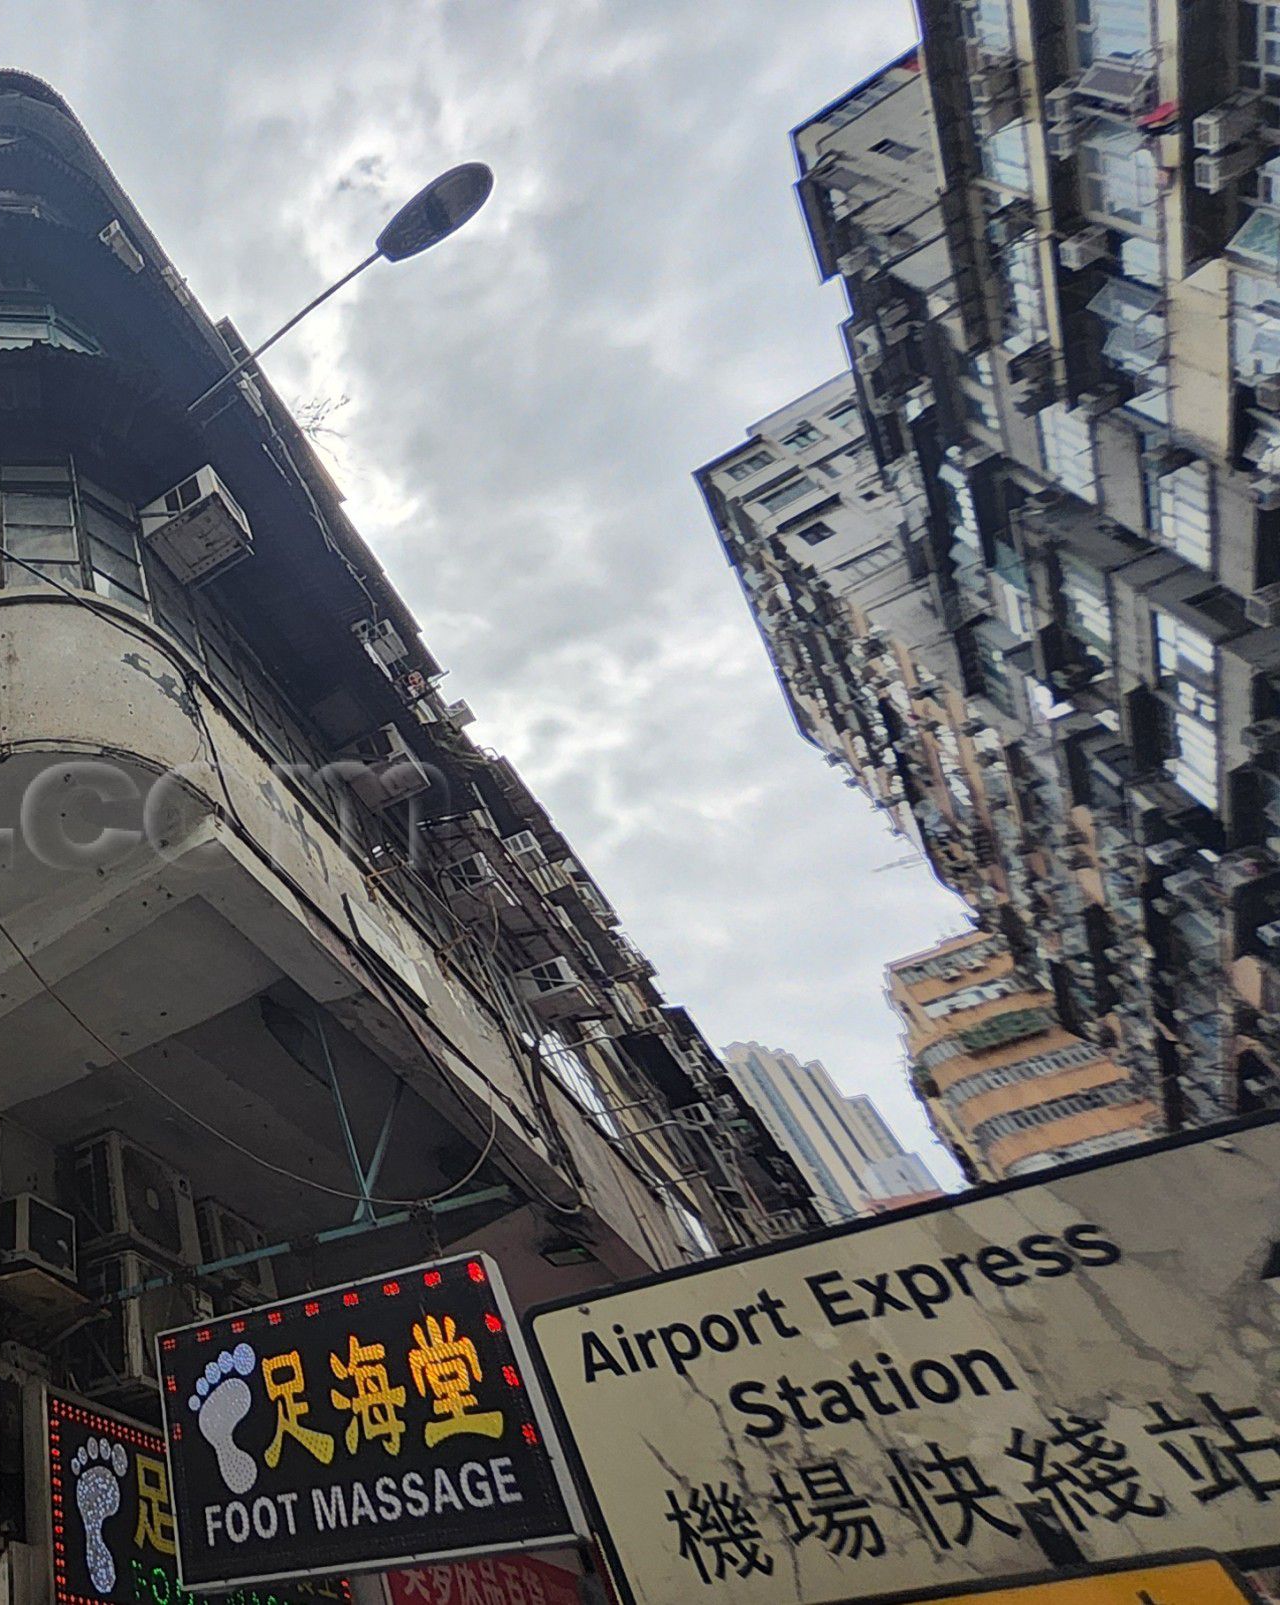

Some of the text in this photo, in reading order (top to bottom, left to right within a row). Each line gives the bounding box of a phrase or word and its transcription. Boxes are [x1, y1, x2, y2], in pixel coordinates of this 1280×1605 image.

[580, 1222, 1122, 1383] Airport Express
[261, 1314, 503, 1470] 足海堂
[729, 1346, 1018, 1439] Station
[205, 1456, 523, 1547] FOOT MASSAGE
